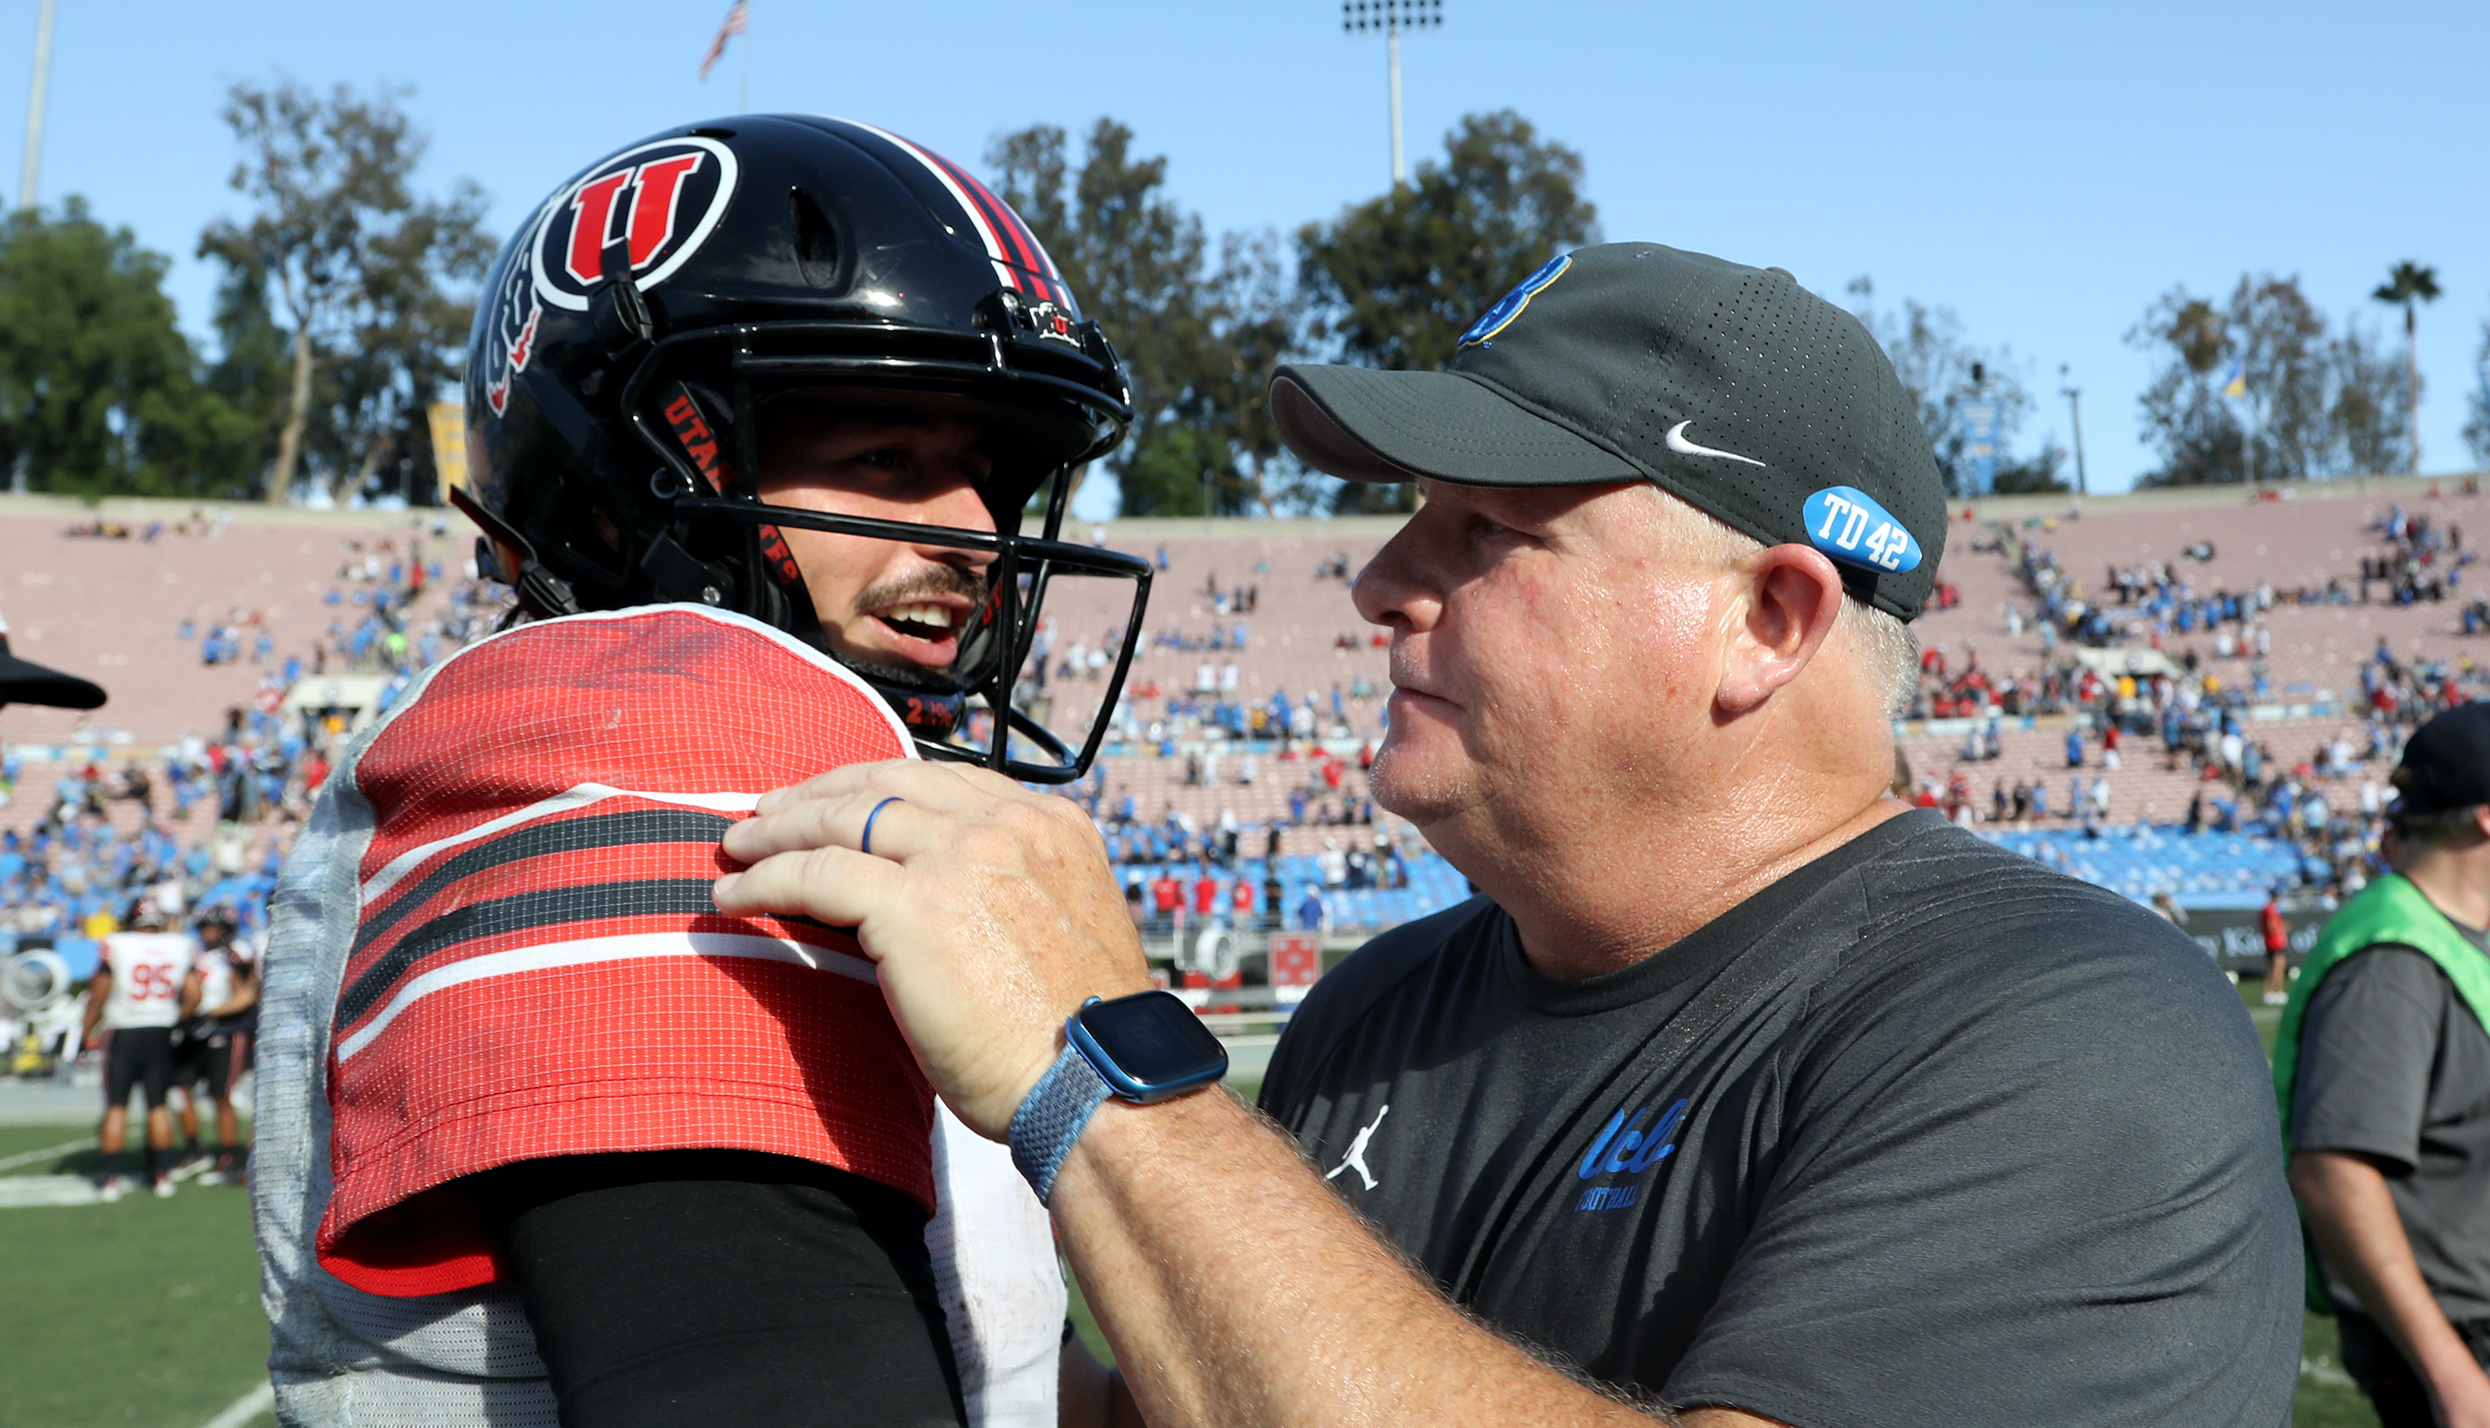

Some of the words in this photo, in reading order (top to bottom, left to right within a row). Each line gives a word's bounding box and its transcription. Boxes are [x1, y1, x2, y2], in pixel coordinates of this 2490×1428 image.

[565, 151, 706, 287] U
[664, 394, 738, 493] UTAH
[759, 523, 799, 586] TES
[1818, 492, 1870, 551] TD
[1864, 521, 1909, 572] 42
[131, 964, 175, 1001] 95
